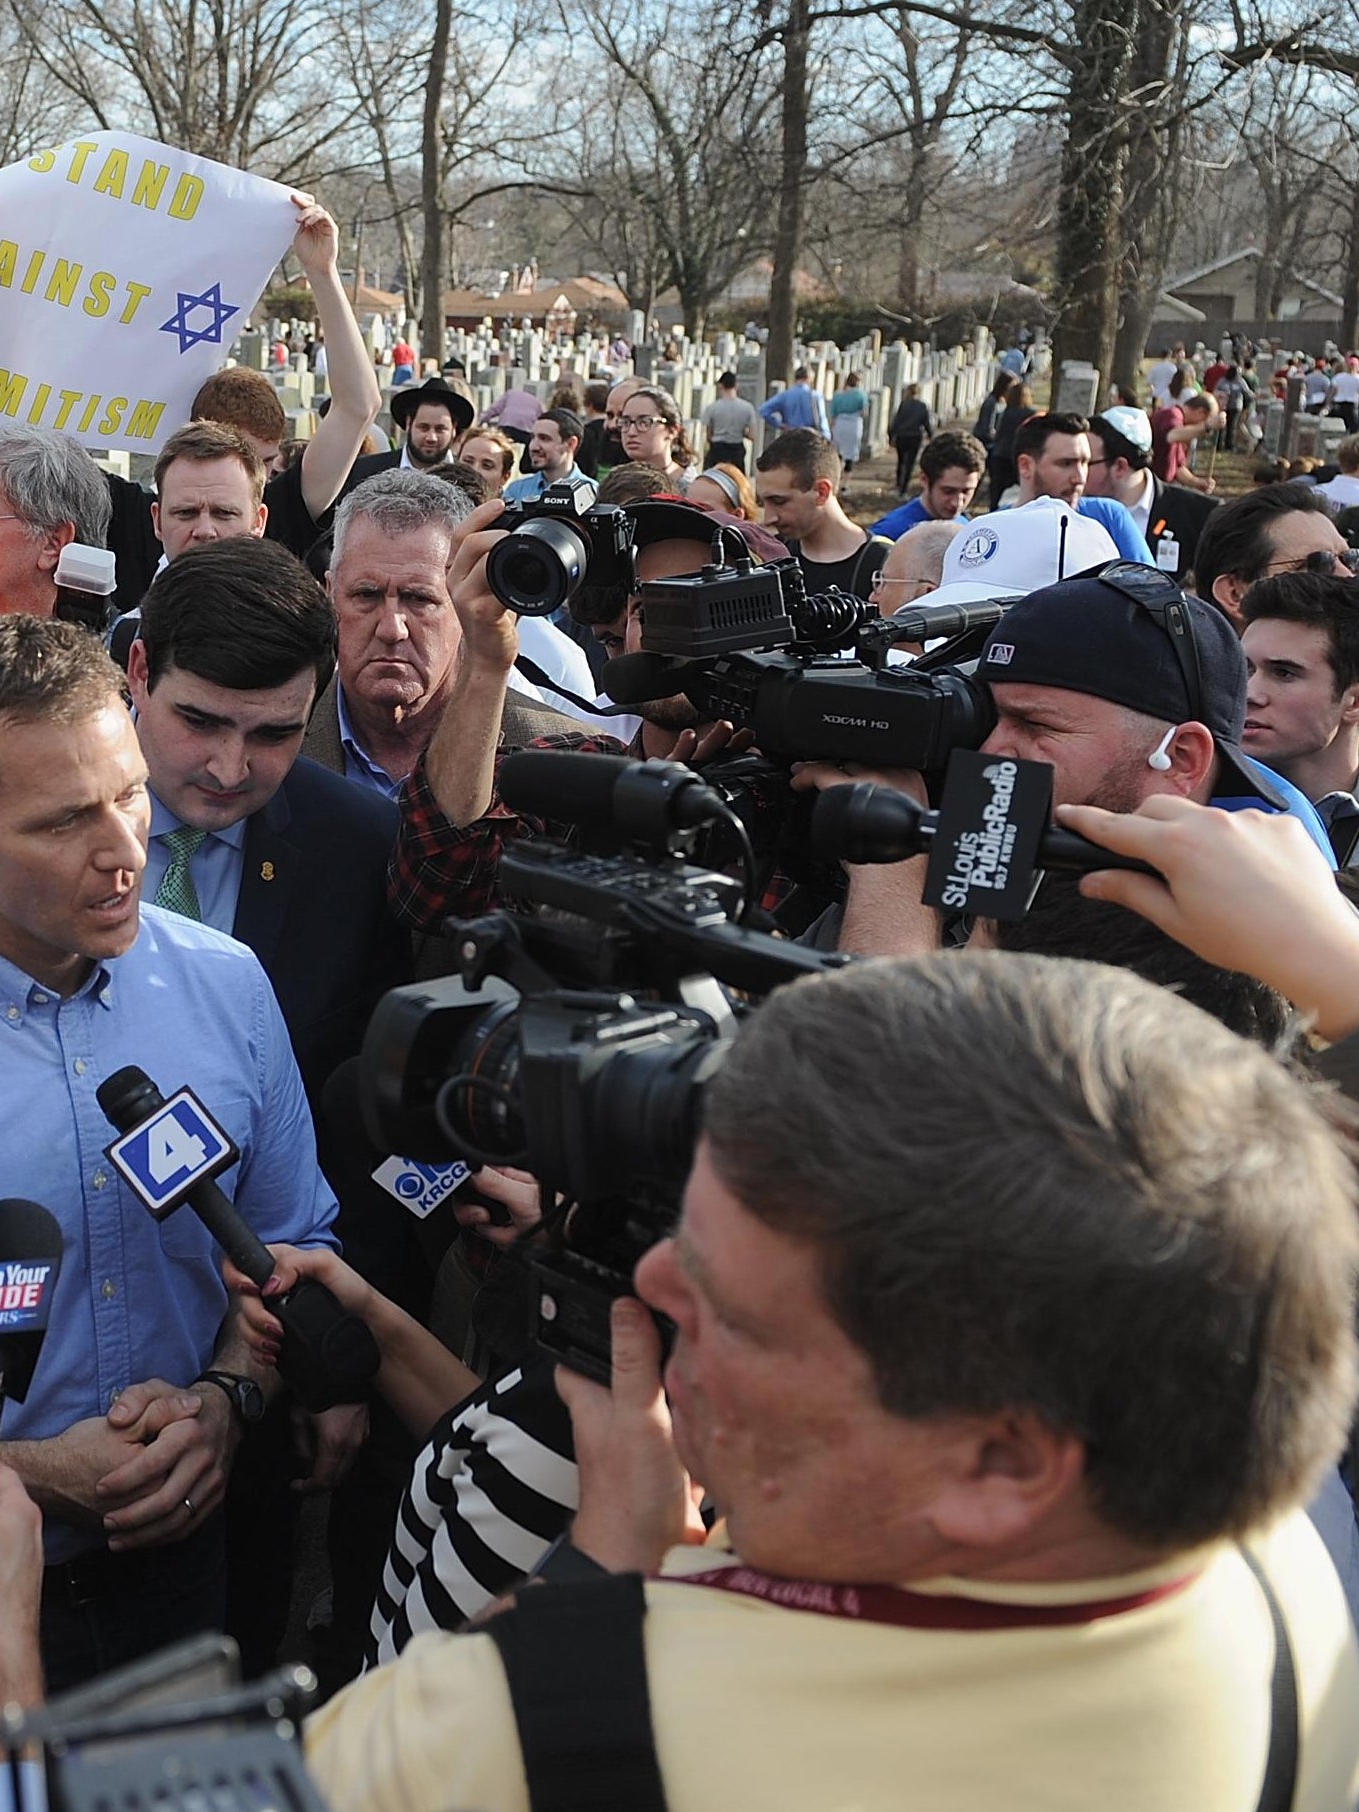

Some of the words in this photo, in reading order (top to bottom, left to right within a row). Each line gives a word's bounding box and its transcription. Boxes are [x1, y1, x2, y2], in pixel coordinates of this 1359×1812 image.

[28, 141, 205, 221] STAND
[544, 497, 570, 505] SONY
[822, 714, 867, 727] XDCAM
[870, 719, 890, 730] HD
[147, 1111, 208, 1186] 4
[418, 1163, 468, 1211] KRCG
[6, 1264, 50, 1286] Your
